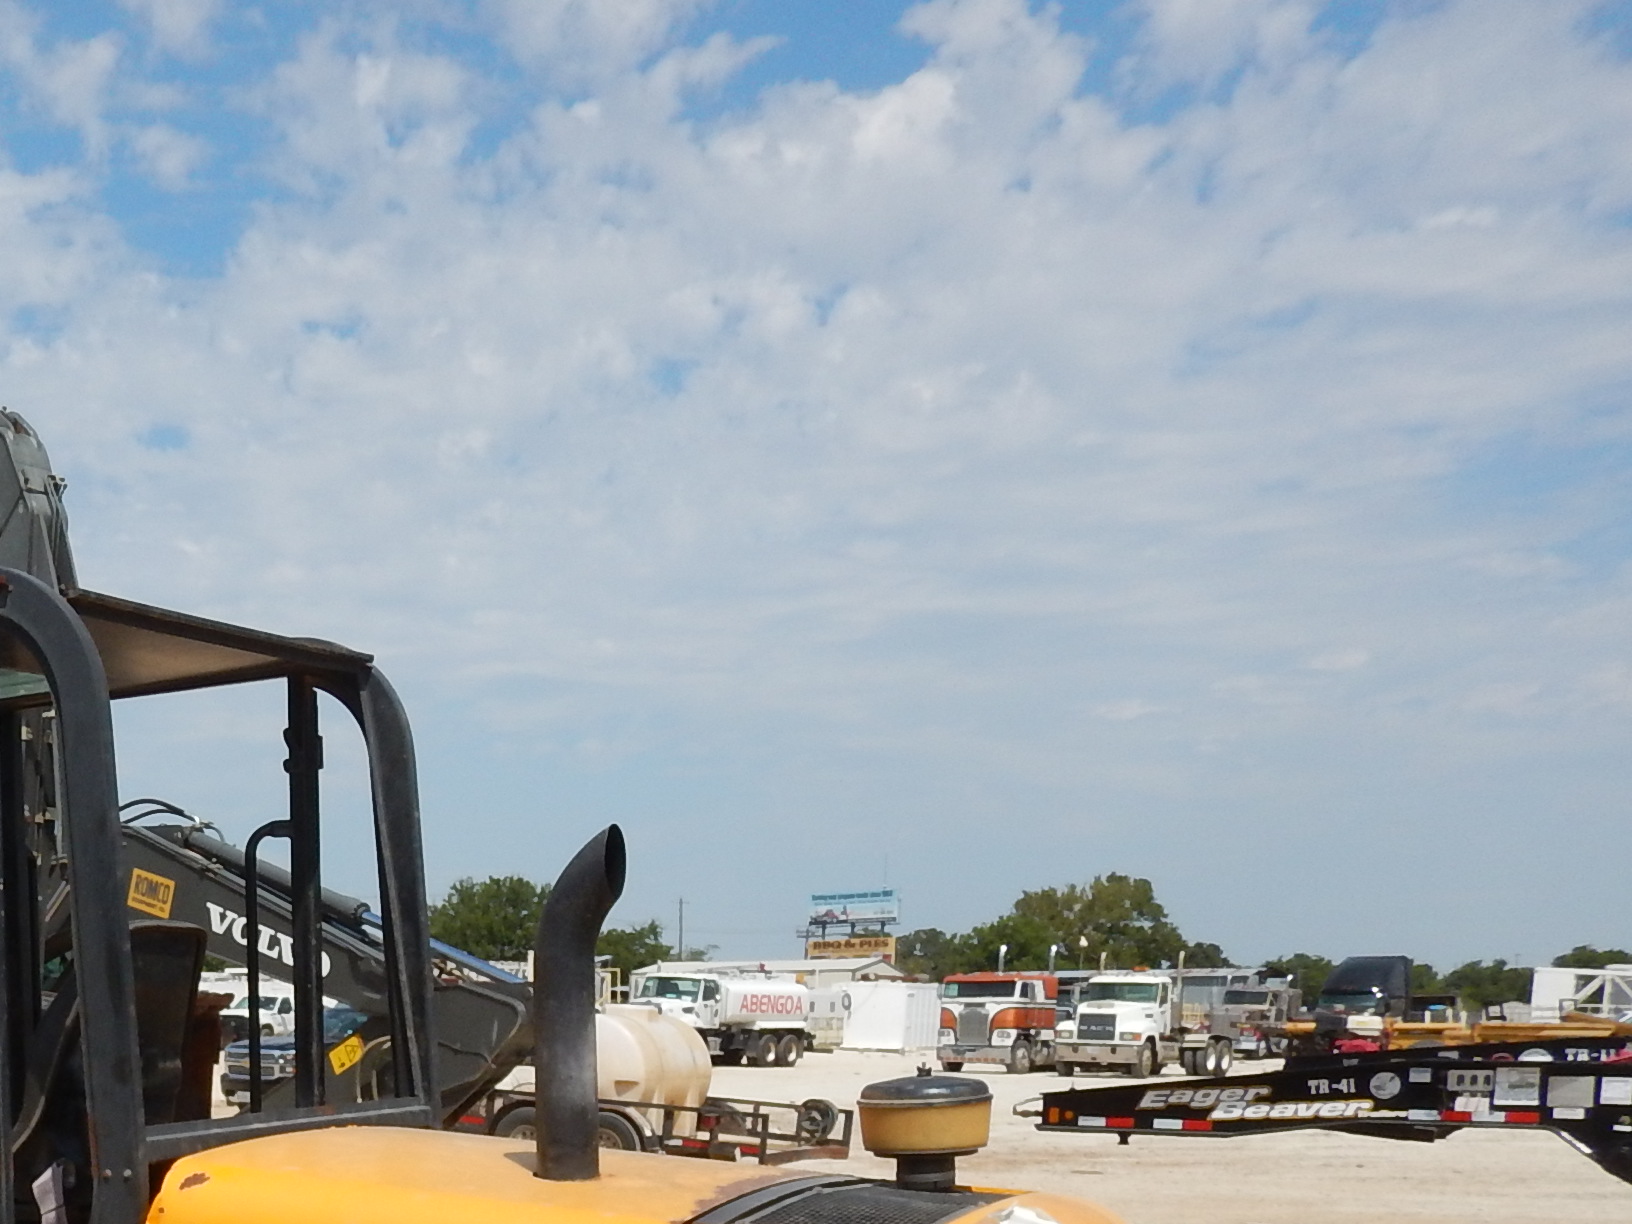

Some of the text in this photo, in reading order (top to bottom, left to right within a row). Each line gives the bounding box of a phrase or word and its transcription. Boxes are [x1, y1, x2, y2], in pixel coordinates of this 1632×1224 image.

[134, 874, 170, 904] ROMCO
[739, 994, 803, 1015] ABENGOA
[1308, 1078, 1356, 1094] TR-41
[1137, 1086, 1271, 1110] Eager
[1208, 1100, 1373, 1121] Beaver
